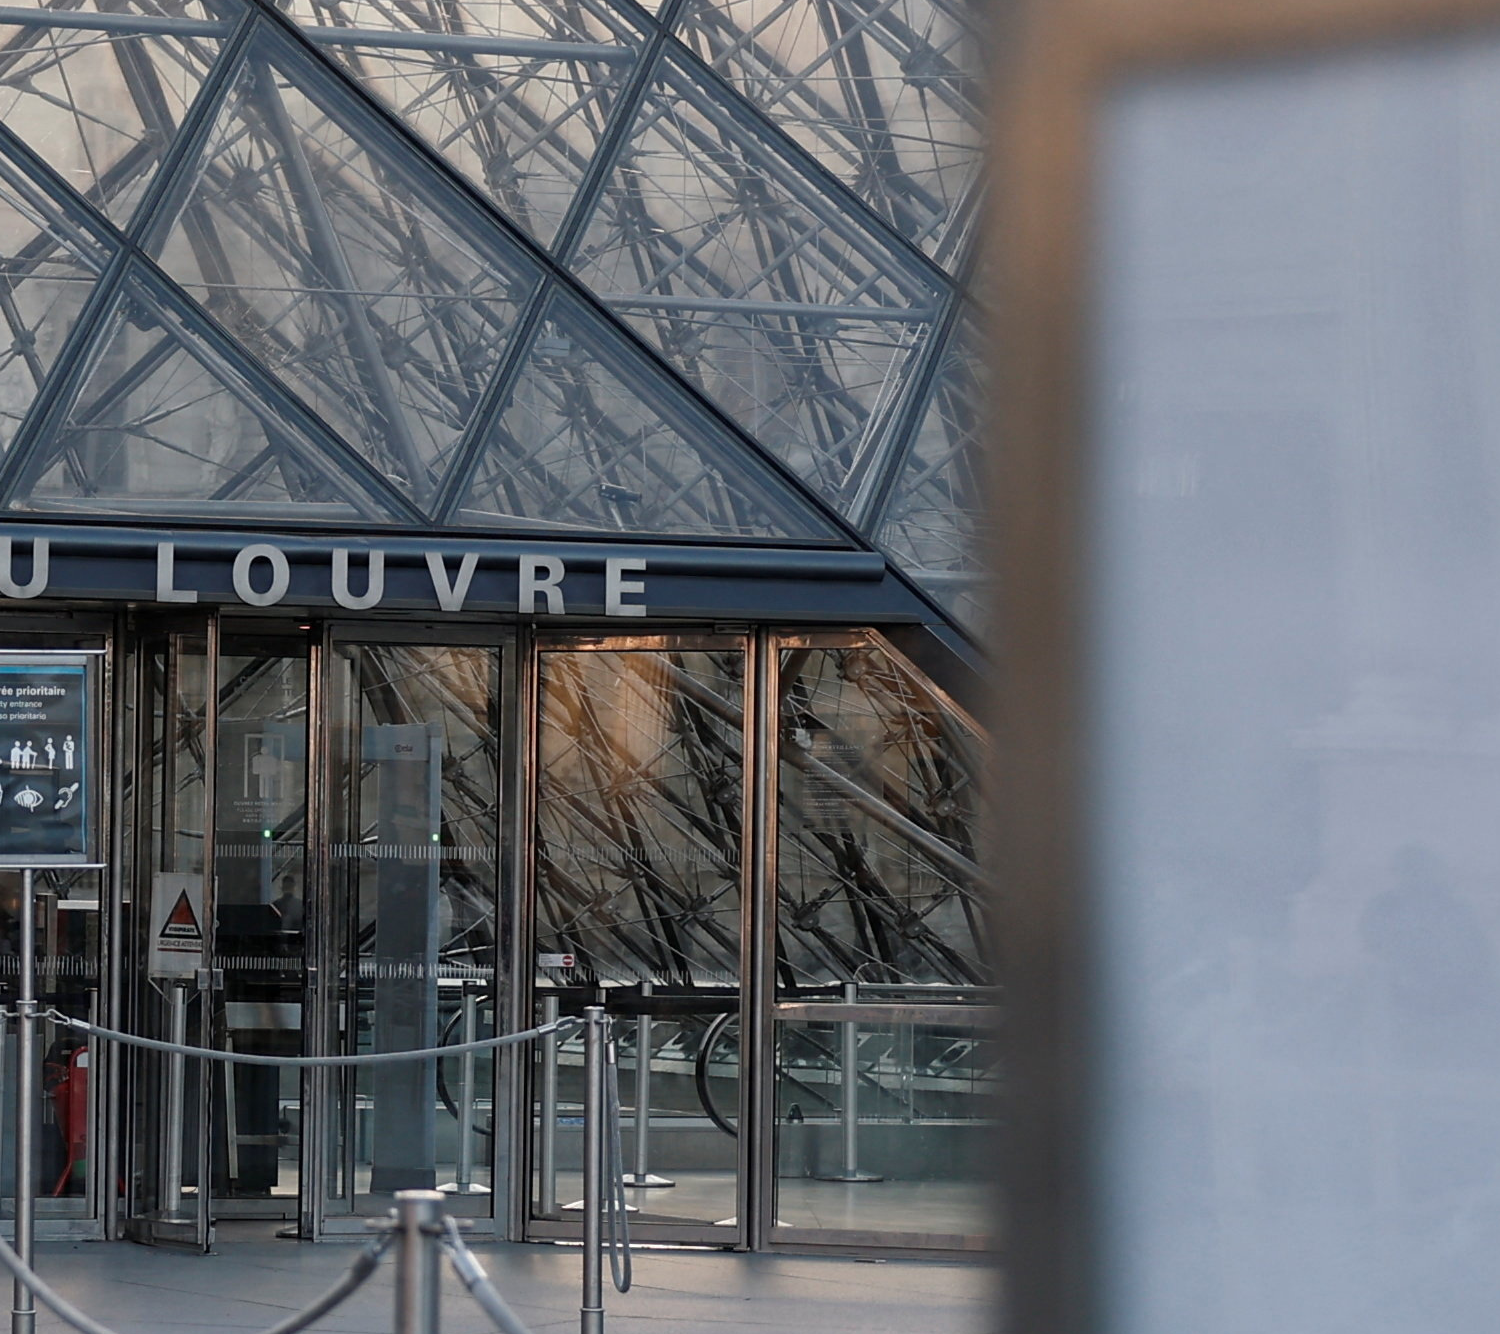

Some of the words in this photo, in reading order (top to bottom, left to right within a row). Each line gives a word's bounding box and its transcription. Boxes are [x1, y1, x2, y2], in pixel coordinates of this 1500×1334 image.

[156, 541, 648, 618] LOUVRE
[16, 685, 66, 697] prioritaire
[9, 712, 47, 721] prioritario
